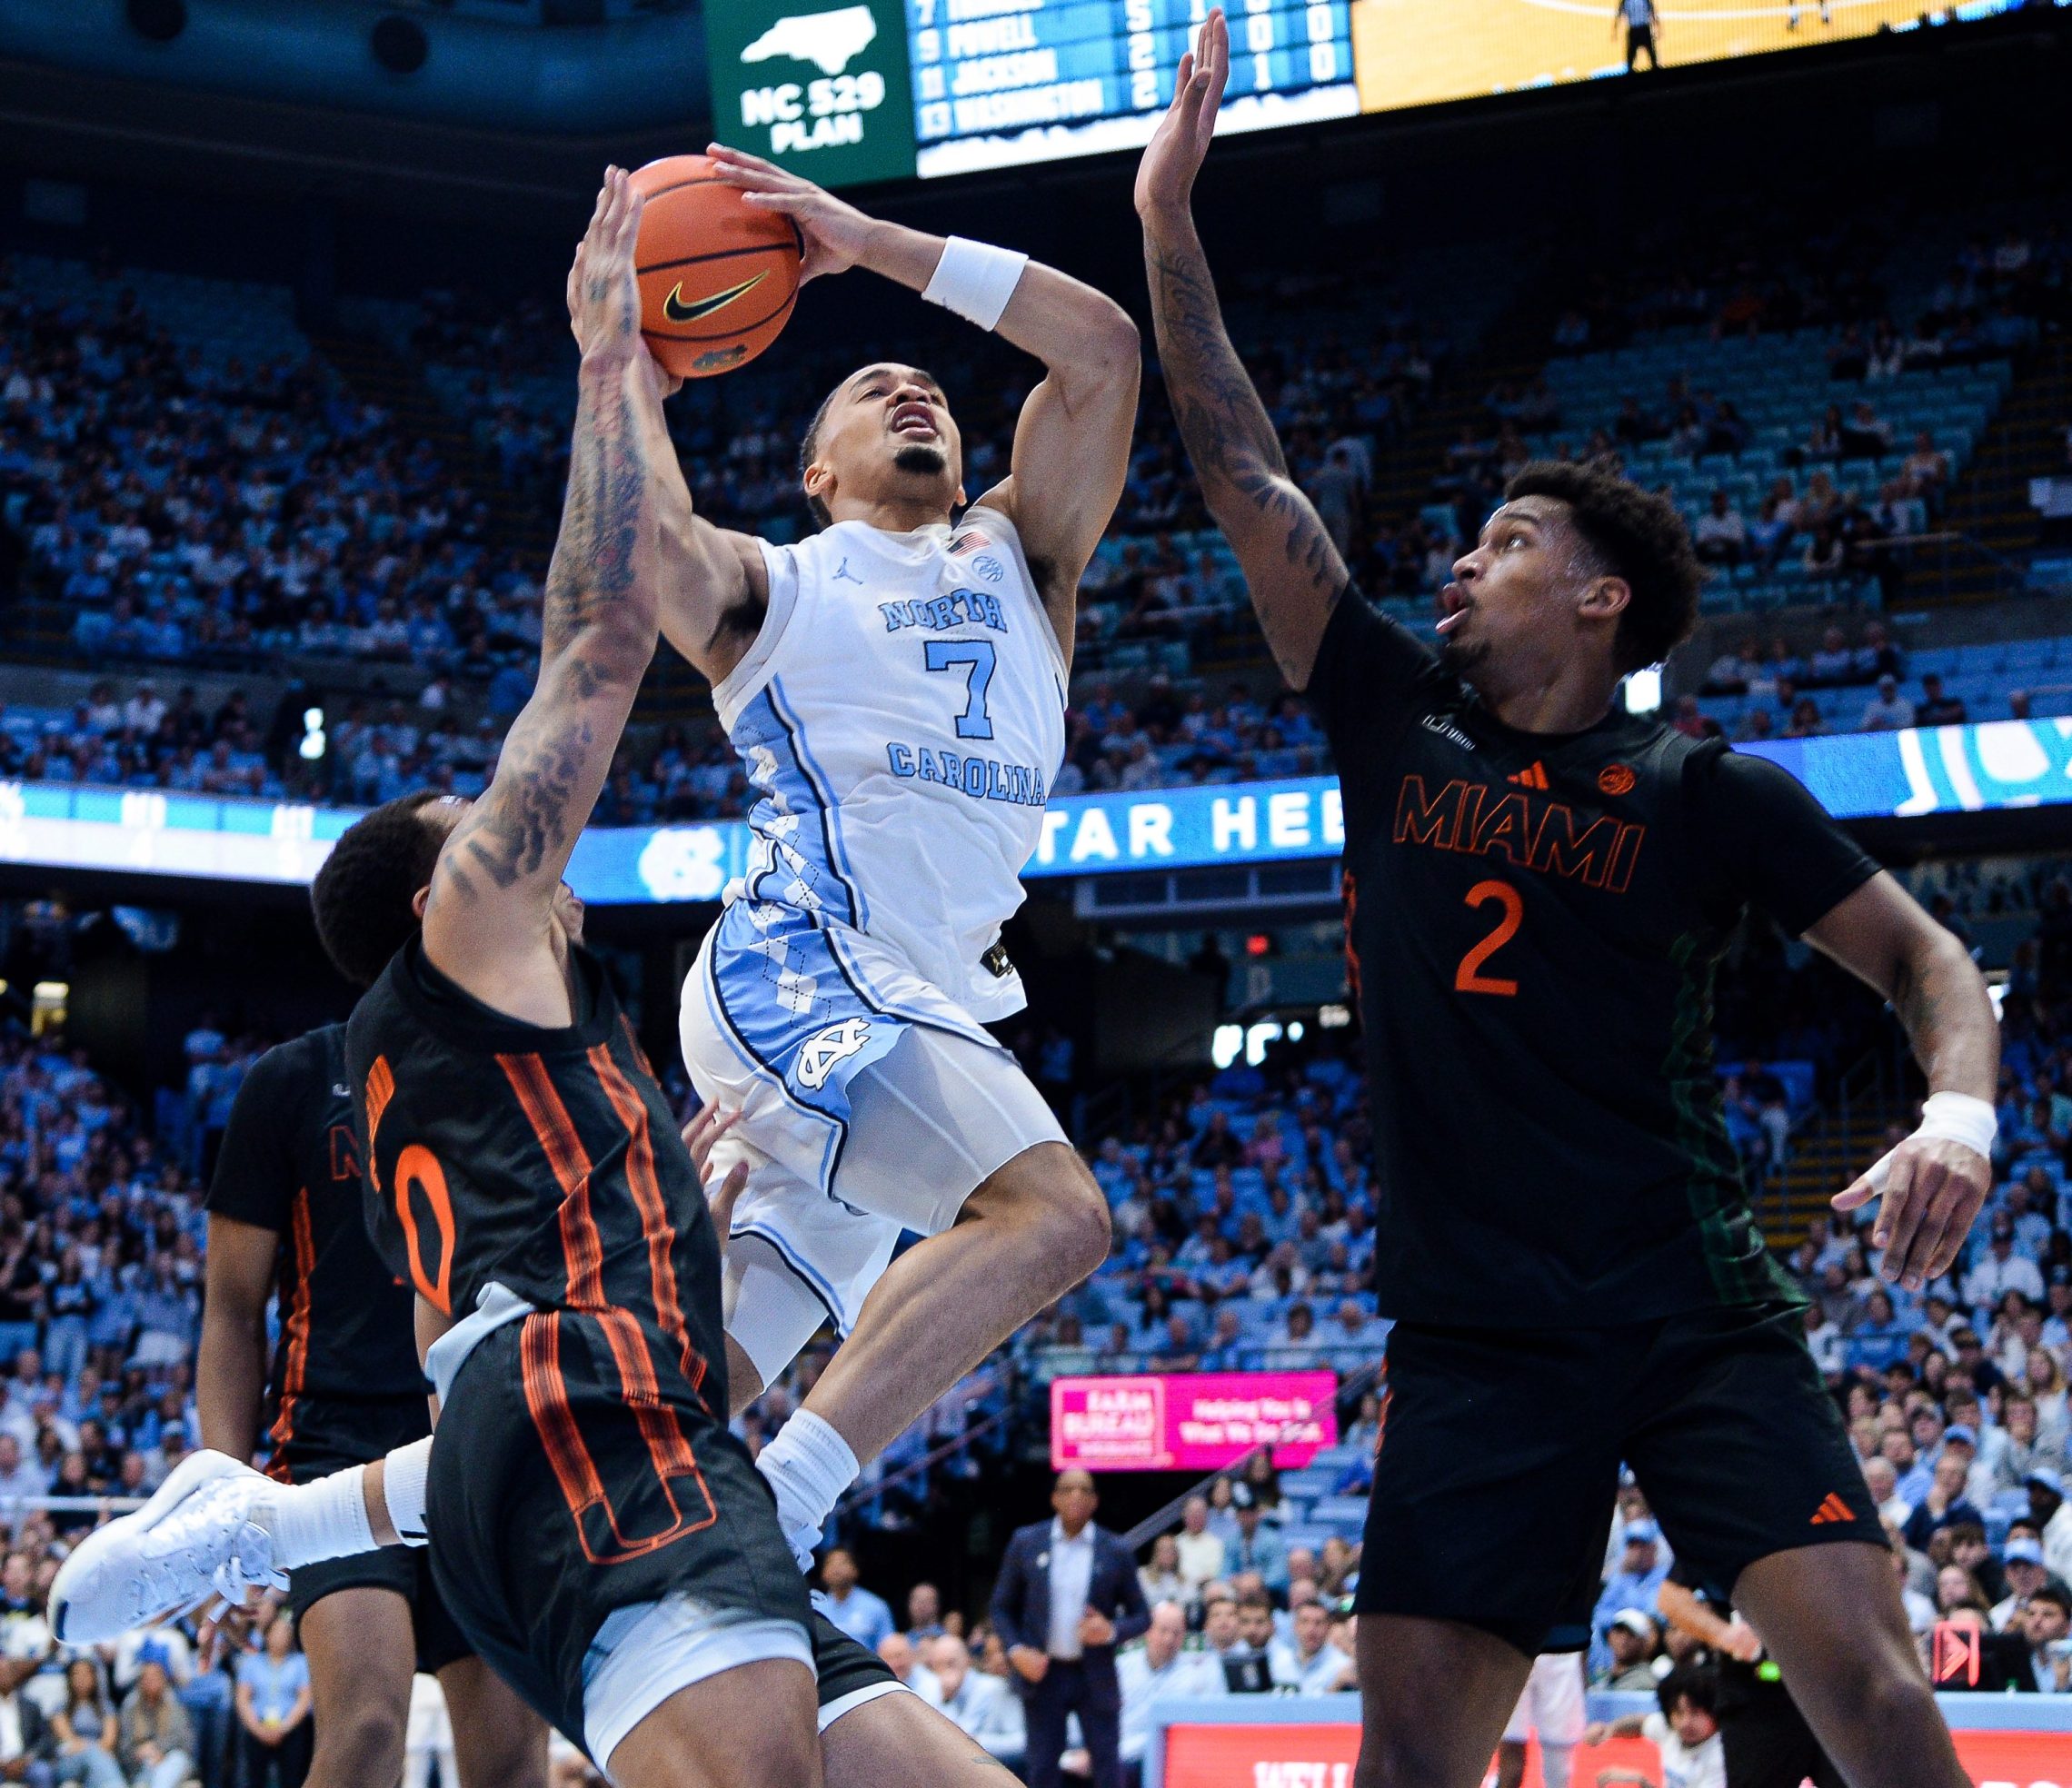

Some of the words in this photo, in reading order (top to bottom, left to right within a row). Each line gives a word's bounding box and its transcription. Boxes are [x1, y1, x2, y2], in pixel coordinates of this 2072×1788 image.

[1128, 32, 1155, 70] 2
[1248, 14, 1273, 53] 0
[1307, 4, 1334, 43] 0
[740, 83, 805, 127] NC
[808, 71, 885, 117] 529
[1131, 69, 1159, 109] 2
[1254, 53, 1270, 91] 1
[1310, 42, 1337, 83] 0
[770, 112, 864, 154] PLAN
[878, 588, 1008, 633] NORTH
[923, 639, 997, 740] 7
[886, 741, 1047, 807] CAROLINA
[1211, 789, 1346, 852] HEE
[1393, 775, 1646, 893] MIAMI
[1455, 879, 1523, 997] 2
[393, 1143, 456, 1317] 0
